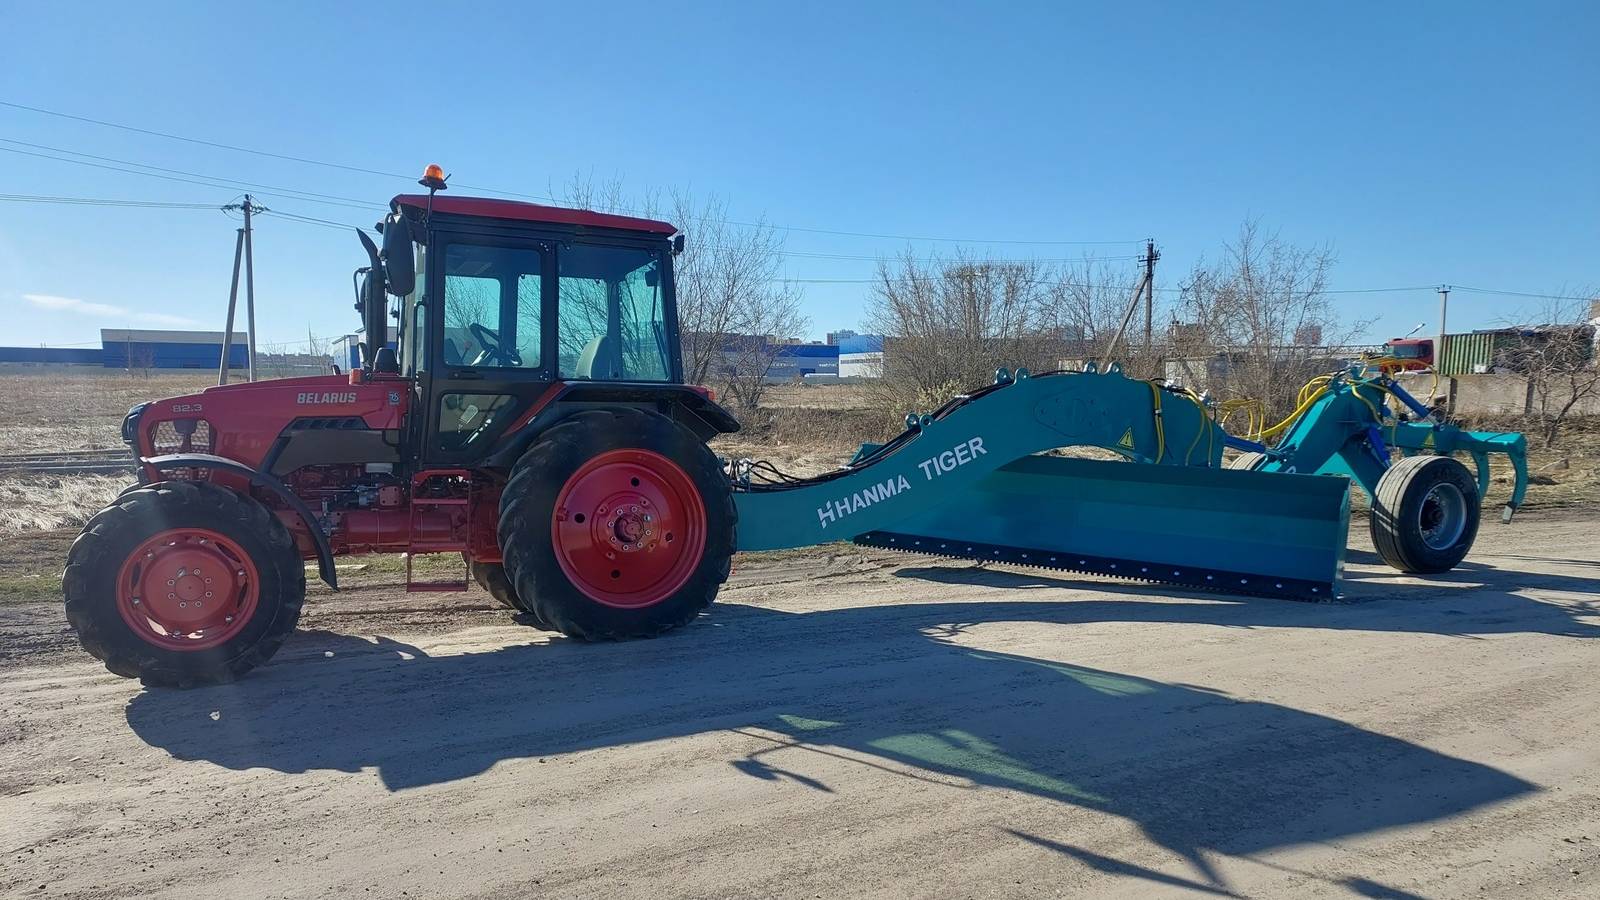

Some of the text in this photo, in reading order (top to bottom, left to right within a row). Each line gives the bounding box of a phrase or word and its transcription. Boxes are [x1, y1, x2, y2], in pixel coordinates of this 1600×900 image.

[297, 392, 357, 404] BELARUS
[173, 404, 203, 413] 82.3
[918, 437, 987, 480] TIGER
